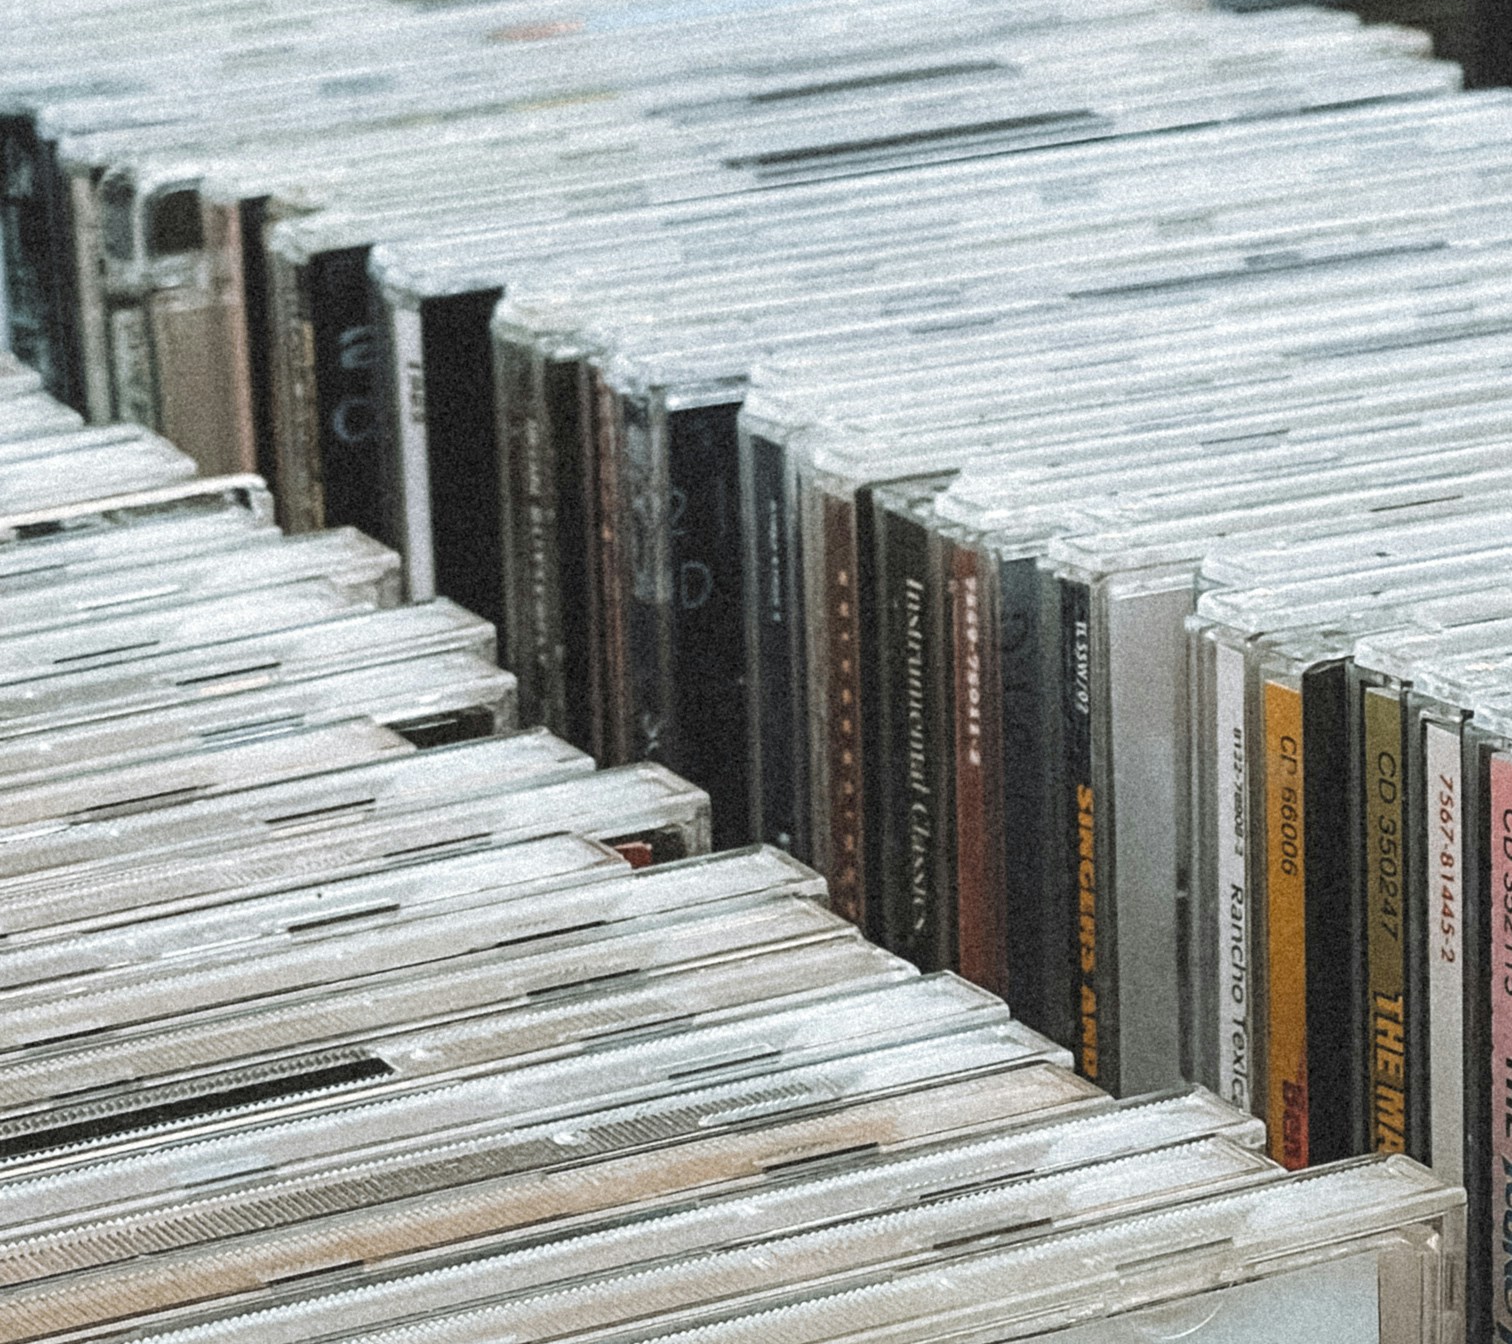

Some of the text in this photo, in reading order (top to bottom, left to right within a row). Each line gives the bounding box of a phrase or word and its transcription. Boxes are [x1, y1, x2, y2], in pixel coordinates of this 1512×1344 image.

[906, 577, 931, 933] Instrumental Classics
[1280, 787, 1298, 877] 66006
[1378, 751, 1399, 940] CD 350247
[1077, 784, 1098, 1078] SINGERS AND
[1230, 884, 1246, 1009] Rancho
[1437, 773, 1456, 964] 7567-81445-2
[1374, 991, 1405, 1074] THE
